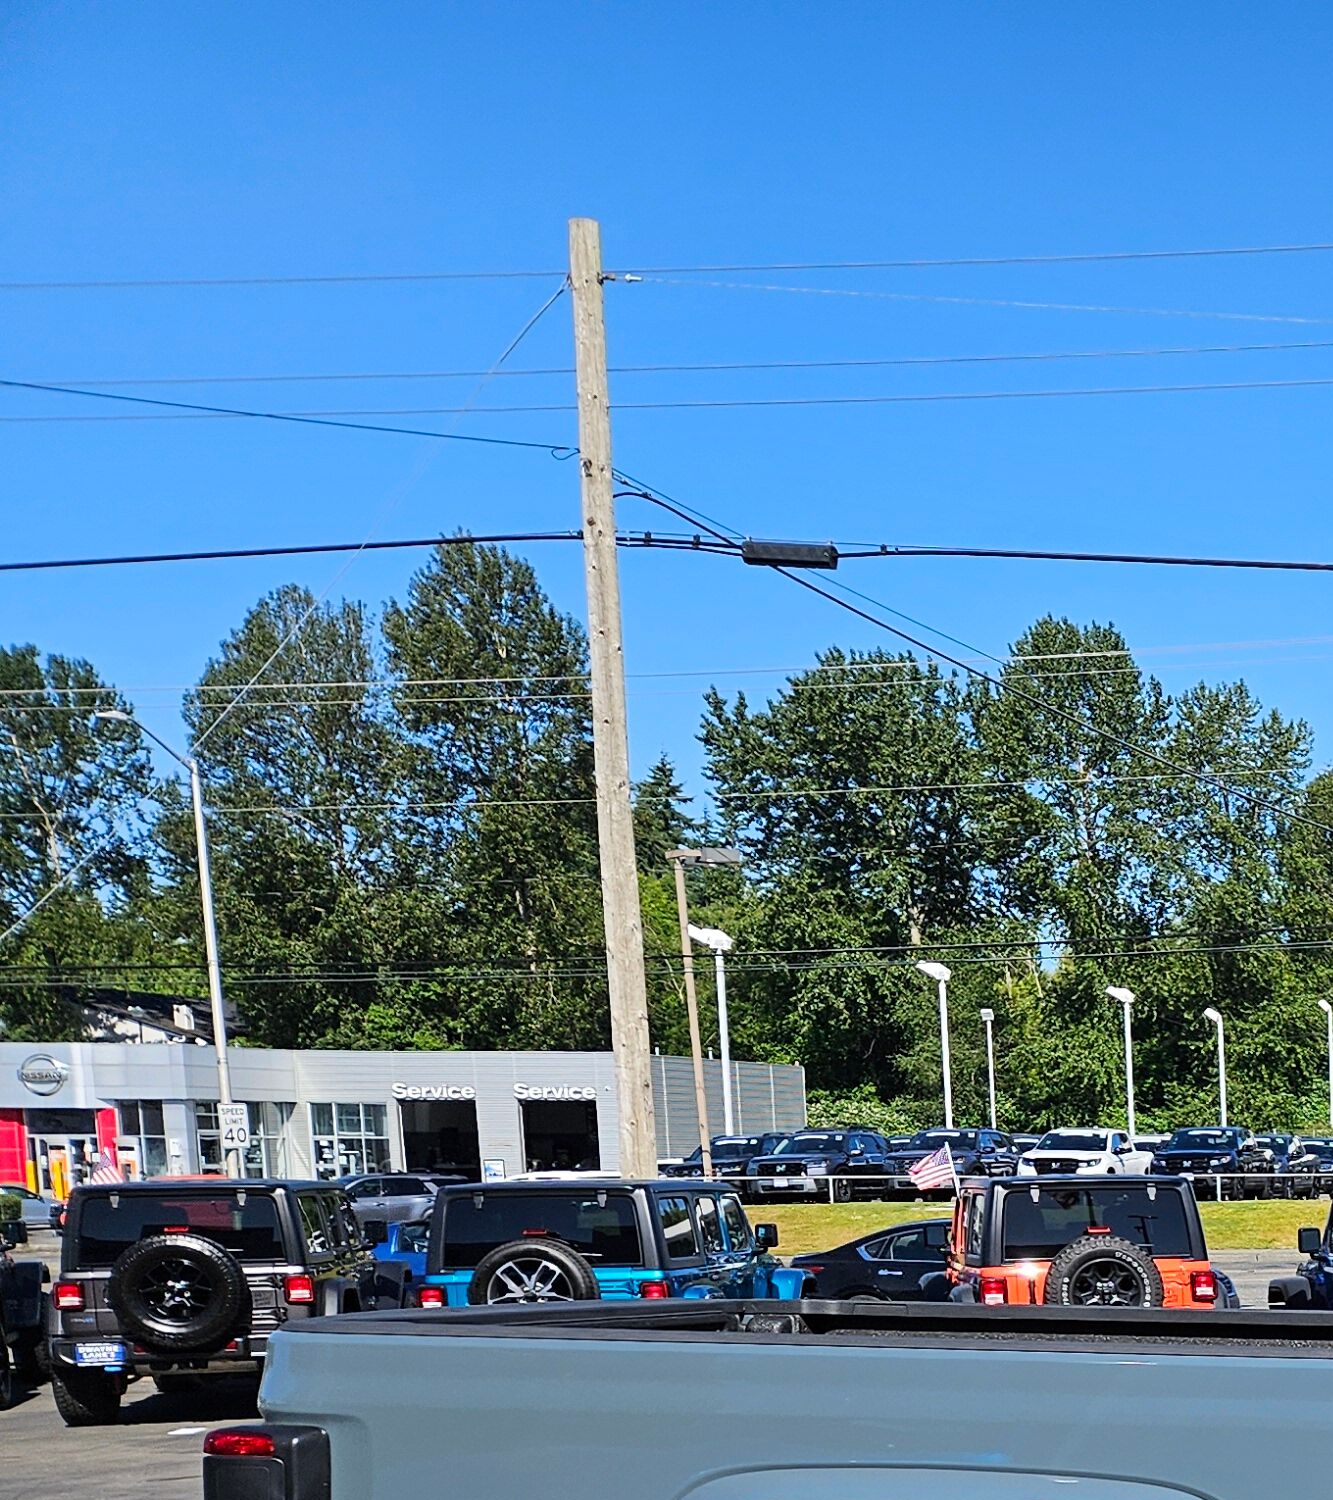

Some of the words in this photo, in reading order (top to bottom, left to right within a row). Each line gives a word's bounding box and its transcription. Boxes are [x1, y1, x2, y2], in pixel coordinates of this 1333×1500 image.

[21, 1071, 62, 1080] NISSAN
[391, 1082, 476, 1100] Service
[513, 1082, 598, 1100] Service
[221, 1107, 245, 1116] SPEED
[224, 1127, 247, 1143] 40
